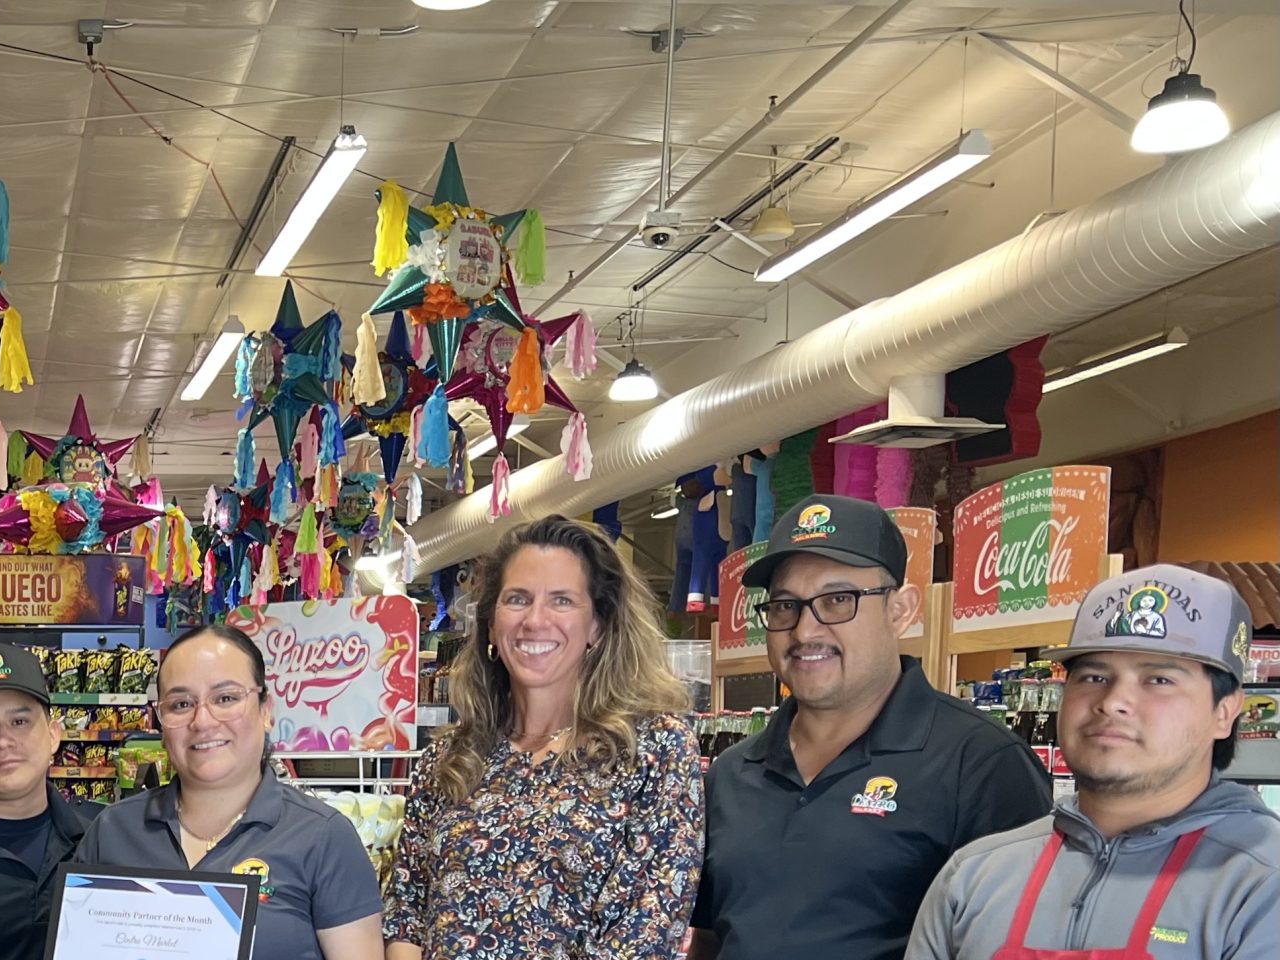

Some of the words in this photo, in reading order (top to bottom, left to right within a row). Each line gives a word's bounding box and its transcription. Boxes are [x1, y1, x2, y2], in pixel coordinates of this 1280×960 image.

[985, 510, 1016, 530] Delicious
[1016, 502, 1030, 517] and
[1030, 501, 1067, 515] Refreshing
[973, 515, 1081, 596] Coca-Cola
[14, 562, 30, 572] OUT
[31, 562, 53, 573] WHAT
[31, 604, 53, 617] LIKE
[1092, 583, 1137, 620] SAN
[88, 908, 131, 919] Community
[133, 911, 163, 920] Partner
[163, 914, 172, 922] of
[172, 914, 185, 923] the
[187, 915, 213, 925] Month
